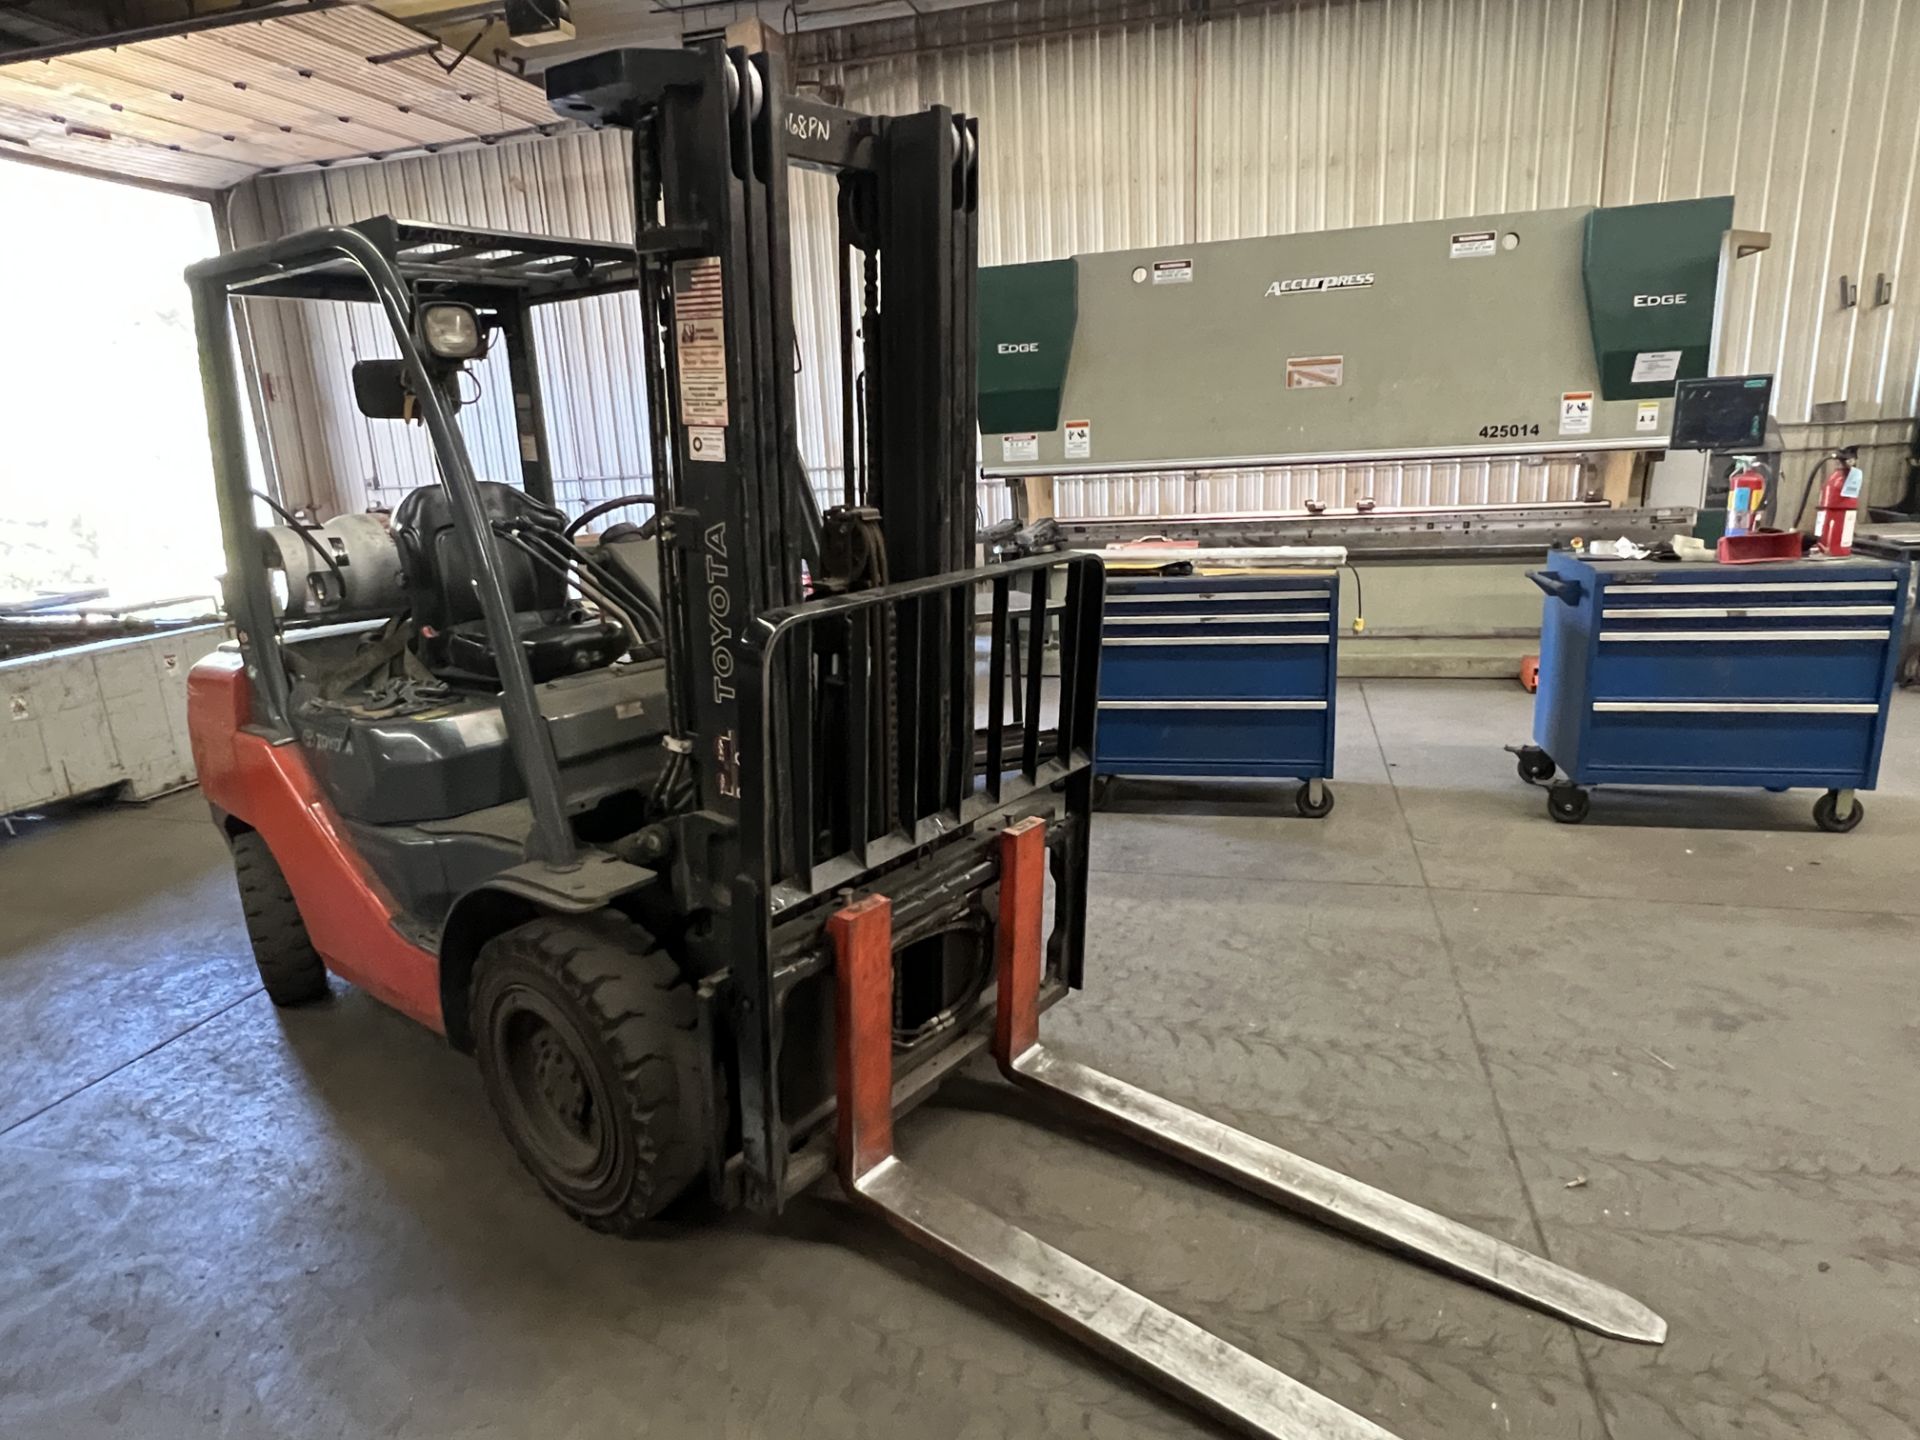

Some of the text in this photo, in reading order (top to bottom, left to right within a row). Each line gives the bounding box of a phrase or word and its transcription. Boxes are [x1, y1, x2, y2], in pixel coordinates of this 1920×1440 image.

[1633, 293, 1688, 308] EDGE
[997, 342, 1040, 354] EDGE
[1478, 424, 1540, 438] 425014
[704, 521, 736, 704] TOYOTA
